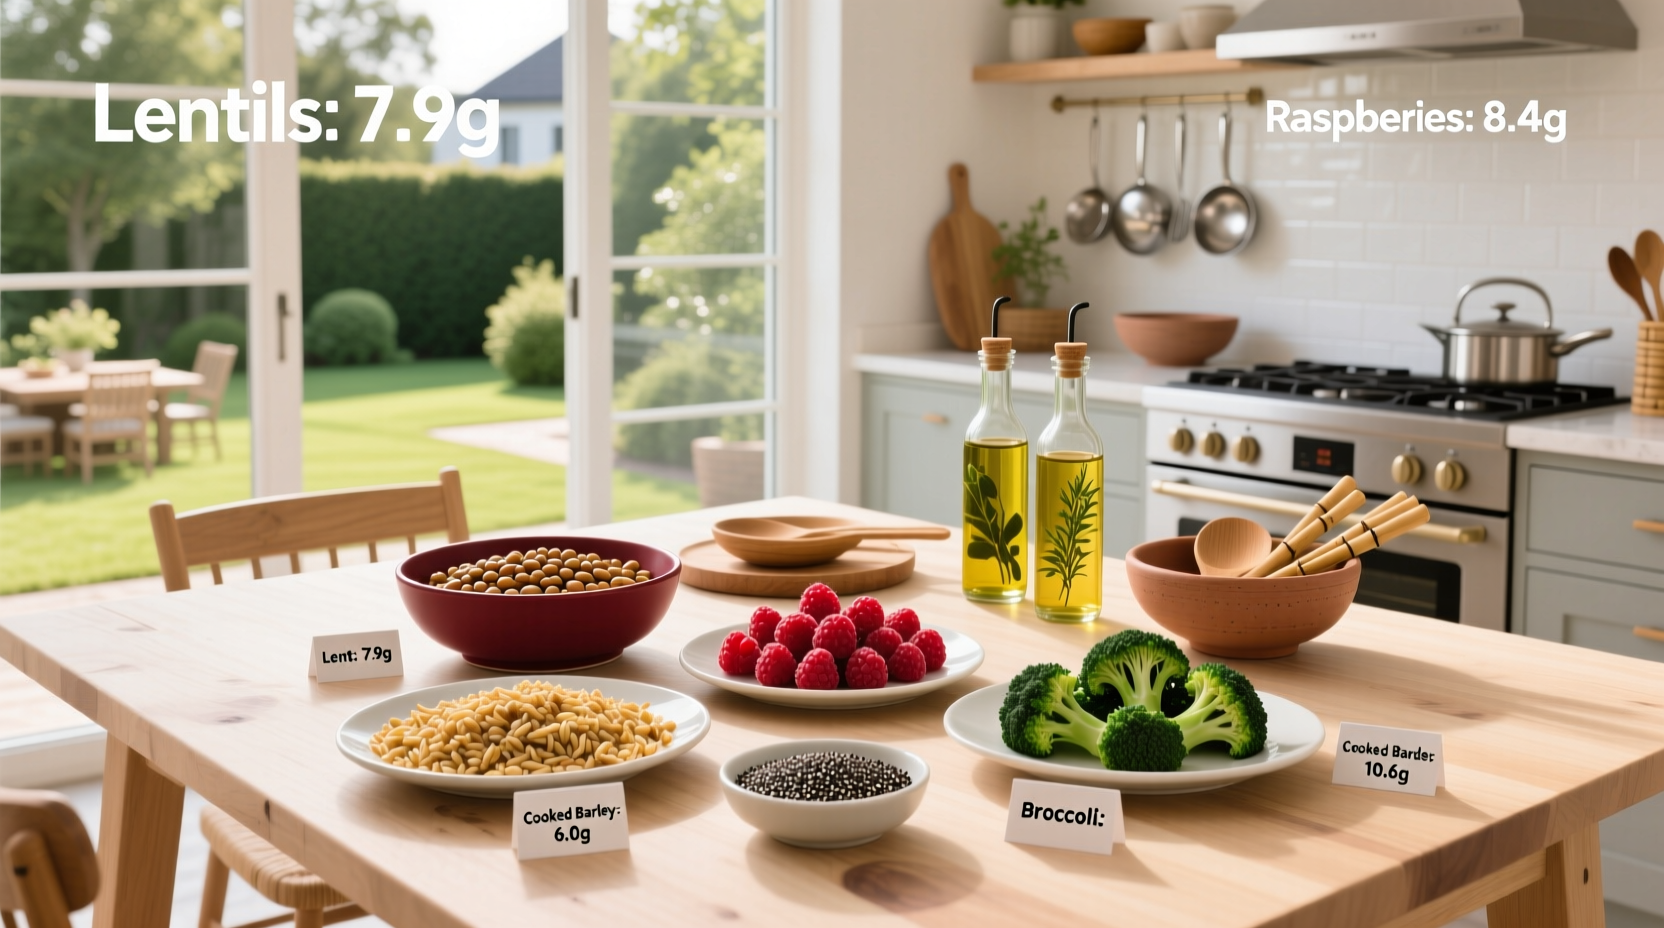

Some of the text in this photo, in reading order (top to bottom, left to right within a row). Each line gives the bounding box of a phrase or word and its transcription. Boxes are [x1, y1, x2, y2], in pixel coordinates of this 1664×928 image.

[322, 646, 392, 664] Lent: 7.9g
[1342, 740, 1389, 757] Cooked
[1365, 761, 1409, 785] 10.6g
[523, 807, 573, 825] Cooked
[1021, 801, 1105, 827] Broccoli:
[554, 825, 591, 845] 6.0g
